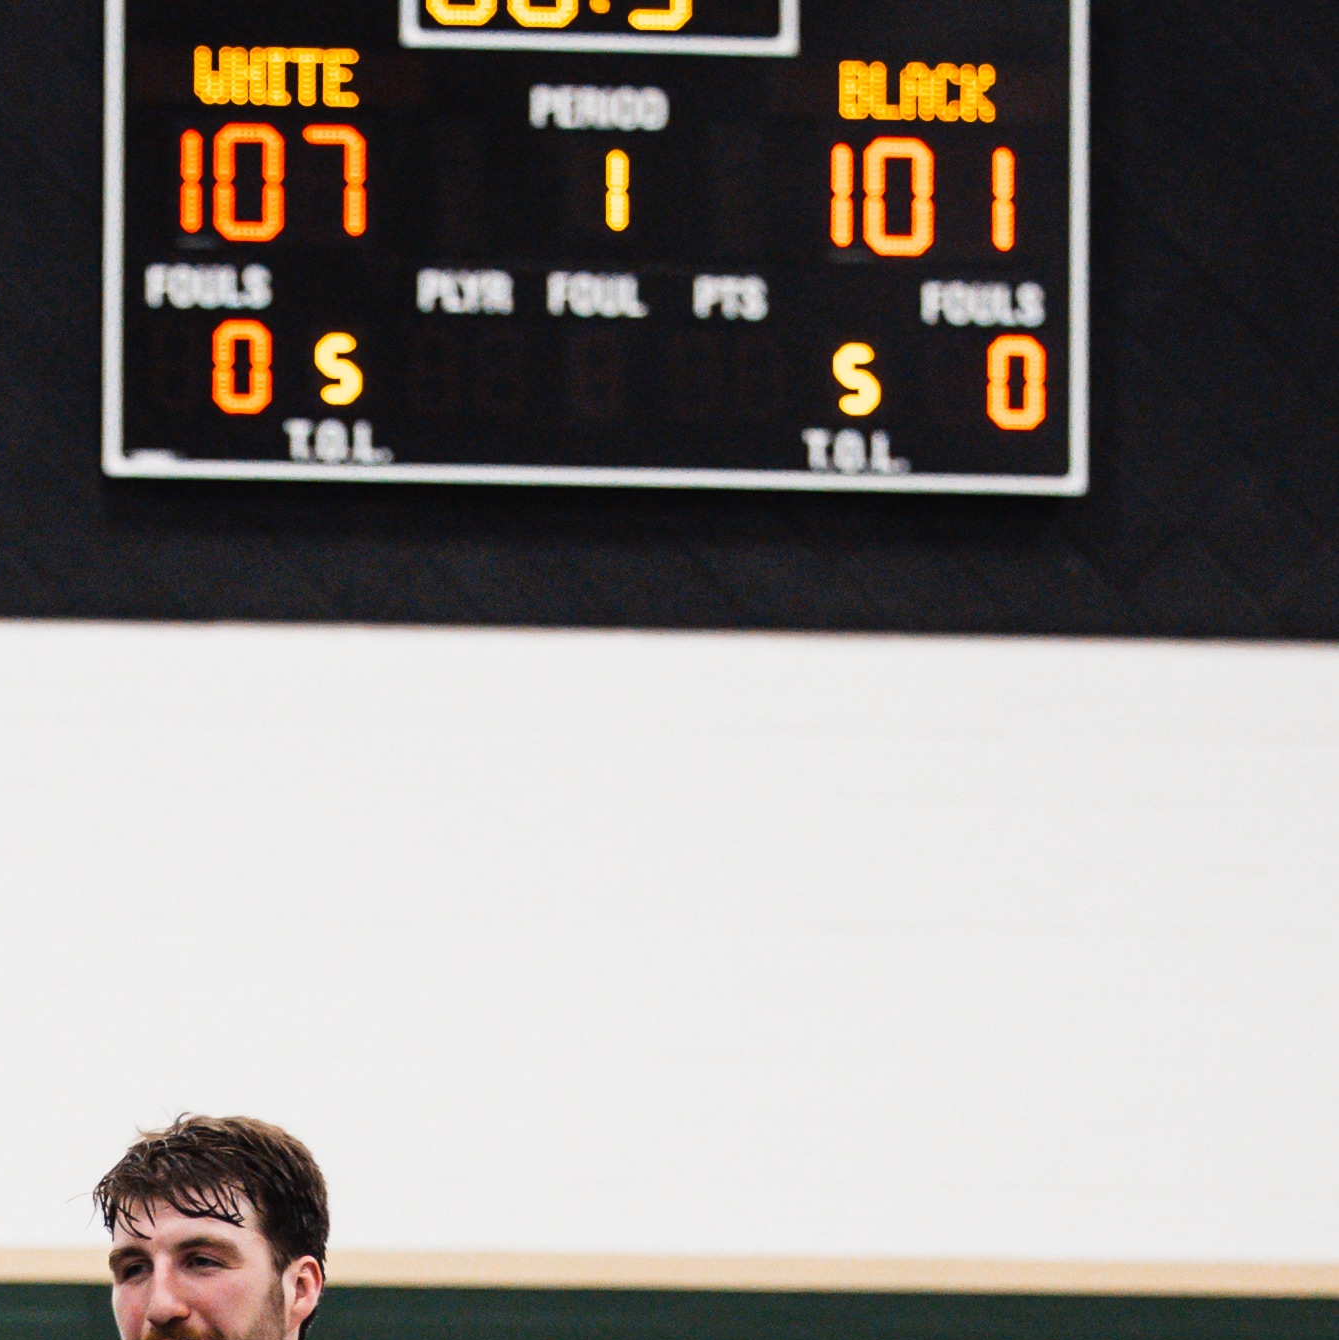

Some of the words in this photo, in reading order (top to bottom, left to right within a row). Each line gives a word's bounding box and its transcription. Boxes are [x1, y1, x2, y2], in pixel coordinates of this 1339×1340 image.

[194, 46, 359, 107] WHITE
[529, 83, 670, 131] PERIOD
[839, 60, 997, 123] BLACK
[179, 122, 367, 242] 107
[606, 149, 630, 231] 1
[829, 136, 1016, 257] 101
[144, 262, 273, 310] FOULS
[416, 268, 514, 315] PLYR
[546, 271, 649, 318] FOUL
[692, 274, 769, 321] PTS
[920, 279, 1047, 328] FOULS
[211, 318, 273, 415] 0
[985, 333, 1047, 431] 0
